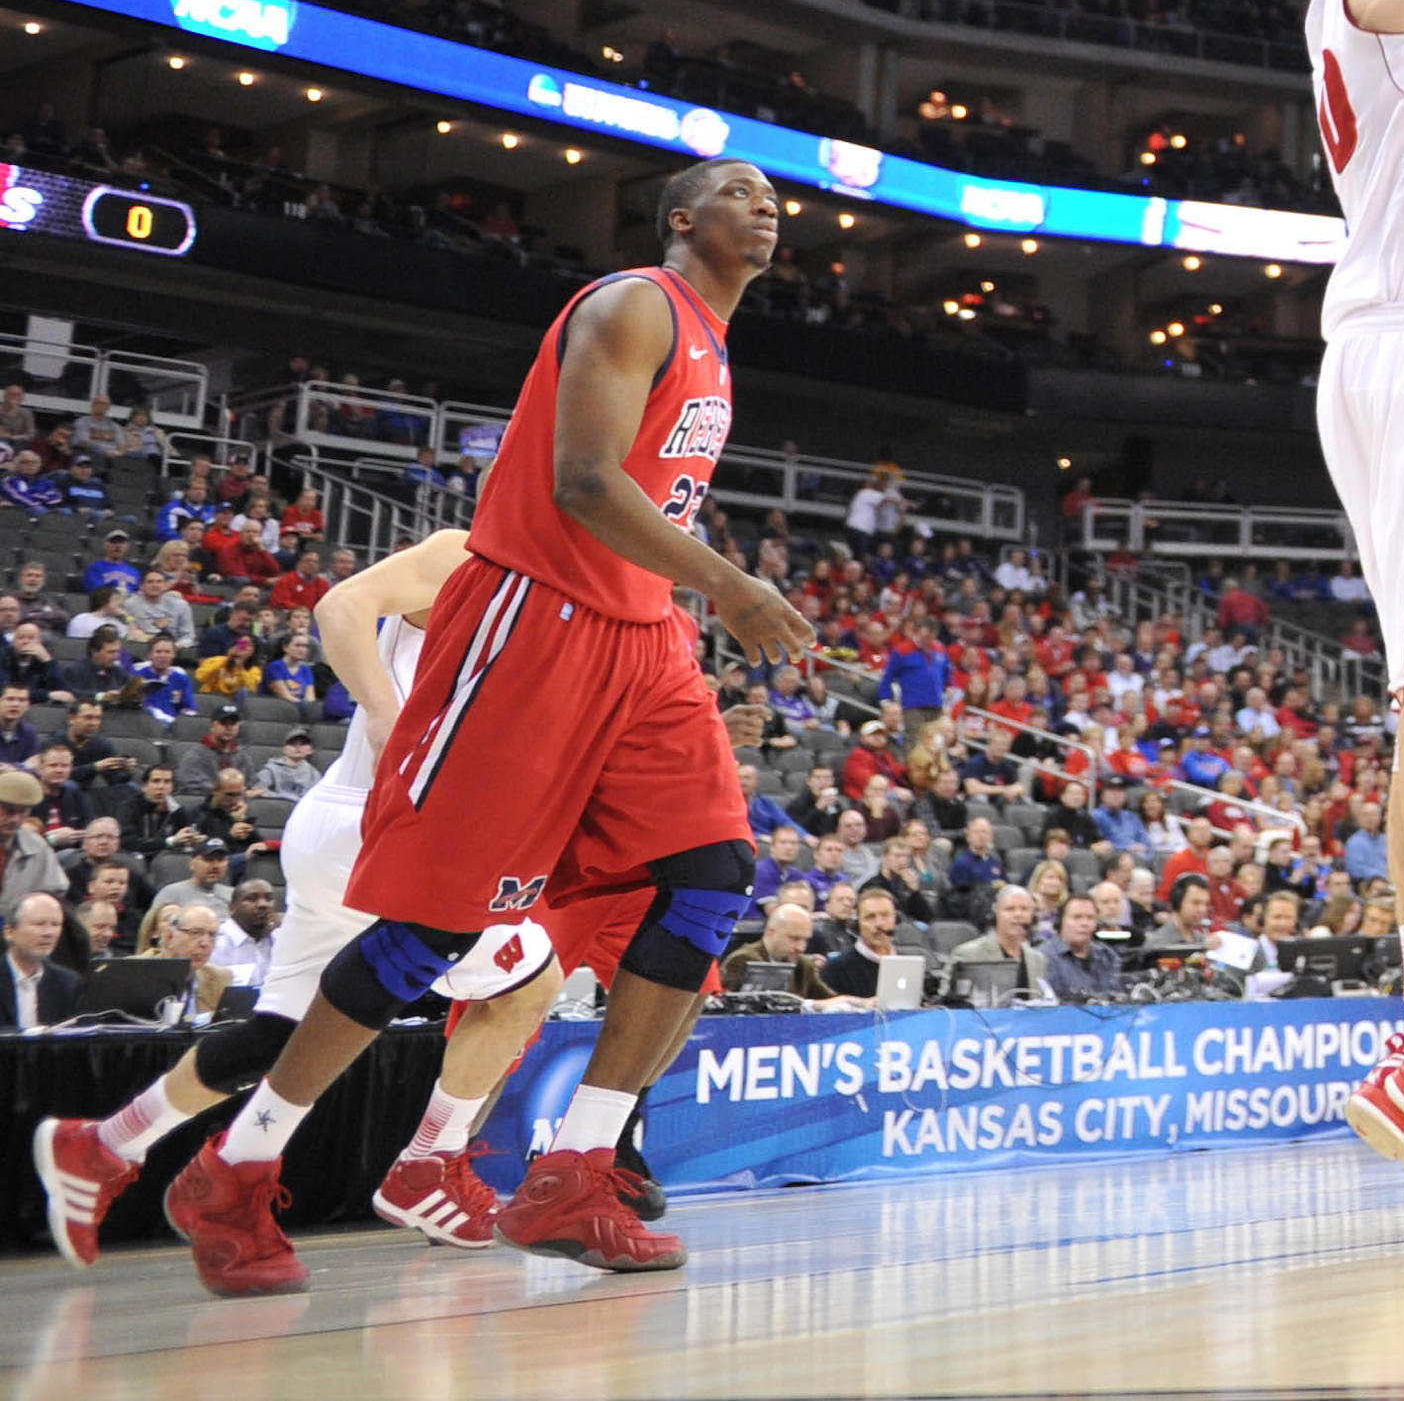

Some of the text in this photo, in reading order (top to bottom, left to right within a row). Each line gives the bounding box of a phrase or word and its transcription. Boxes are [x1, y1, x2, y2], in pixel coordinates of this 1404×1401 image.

[126, 205, 153, 239] 0
[696, 1041, 865, 1103] MEN'S
[877, 1030, 1187, 1094] BASKETBALL
[882, 1101, 1063, 1157] KANSAS
[1075, 1093, 1179, 1145] CITY,
